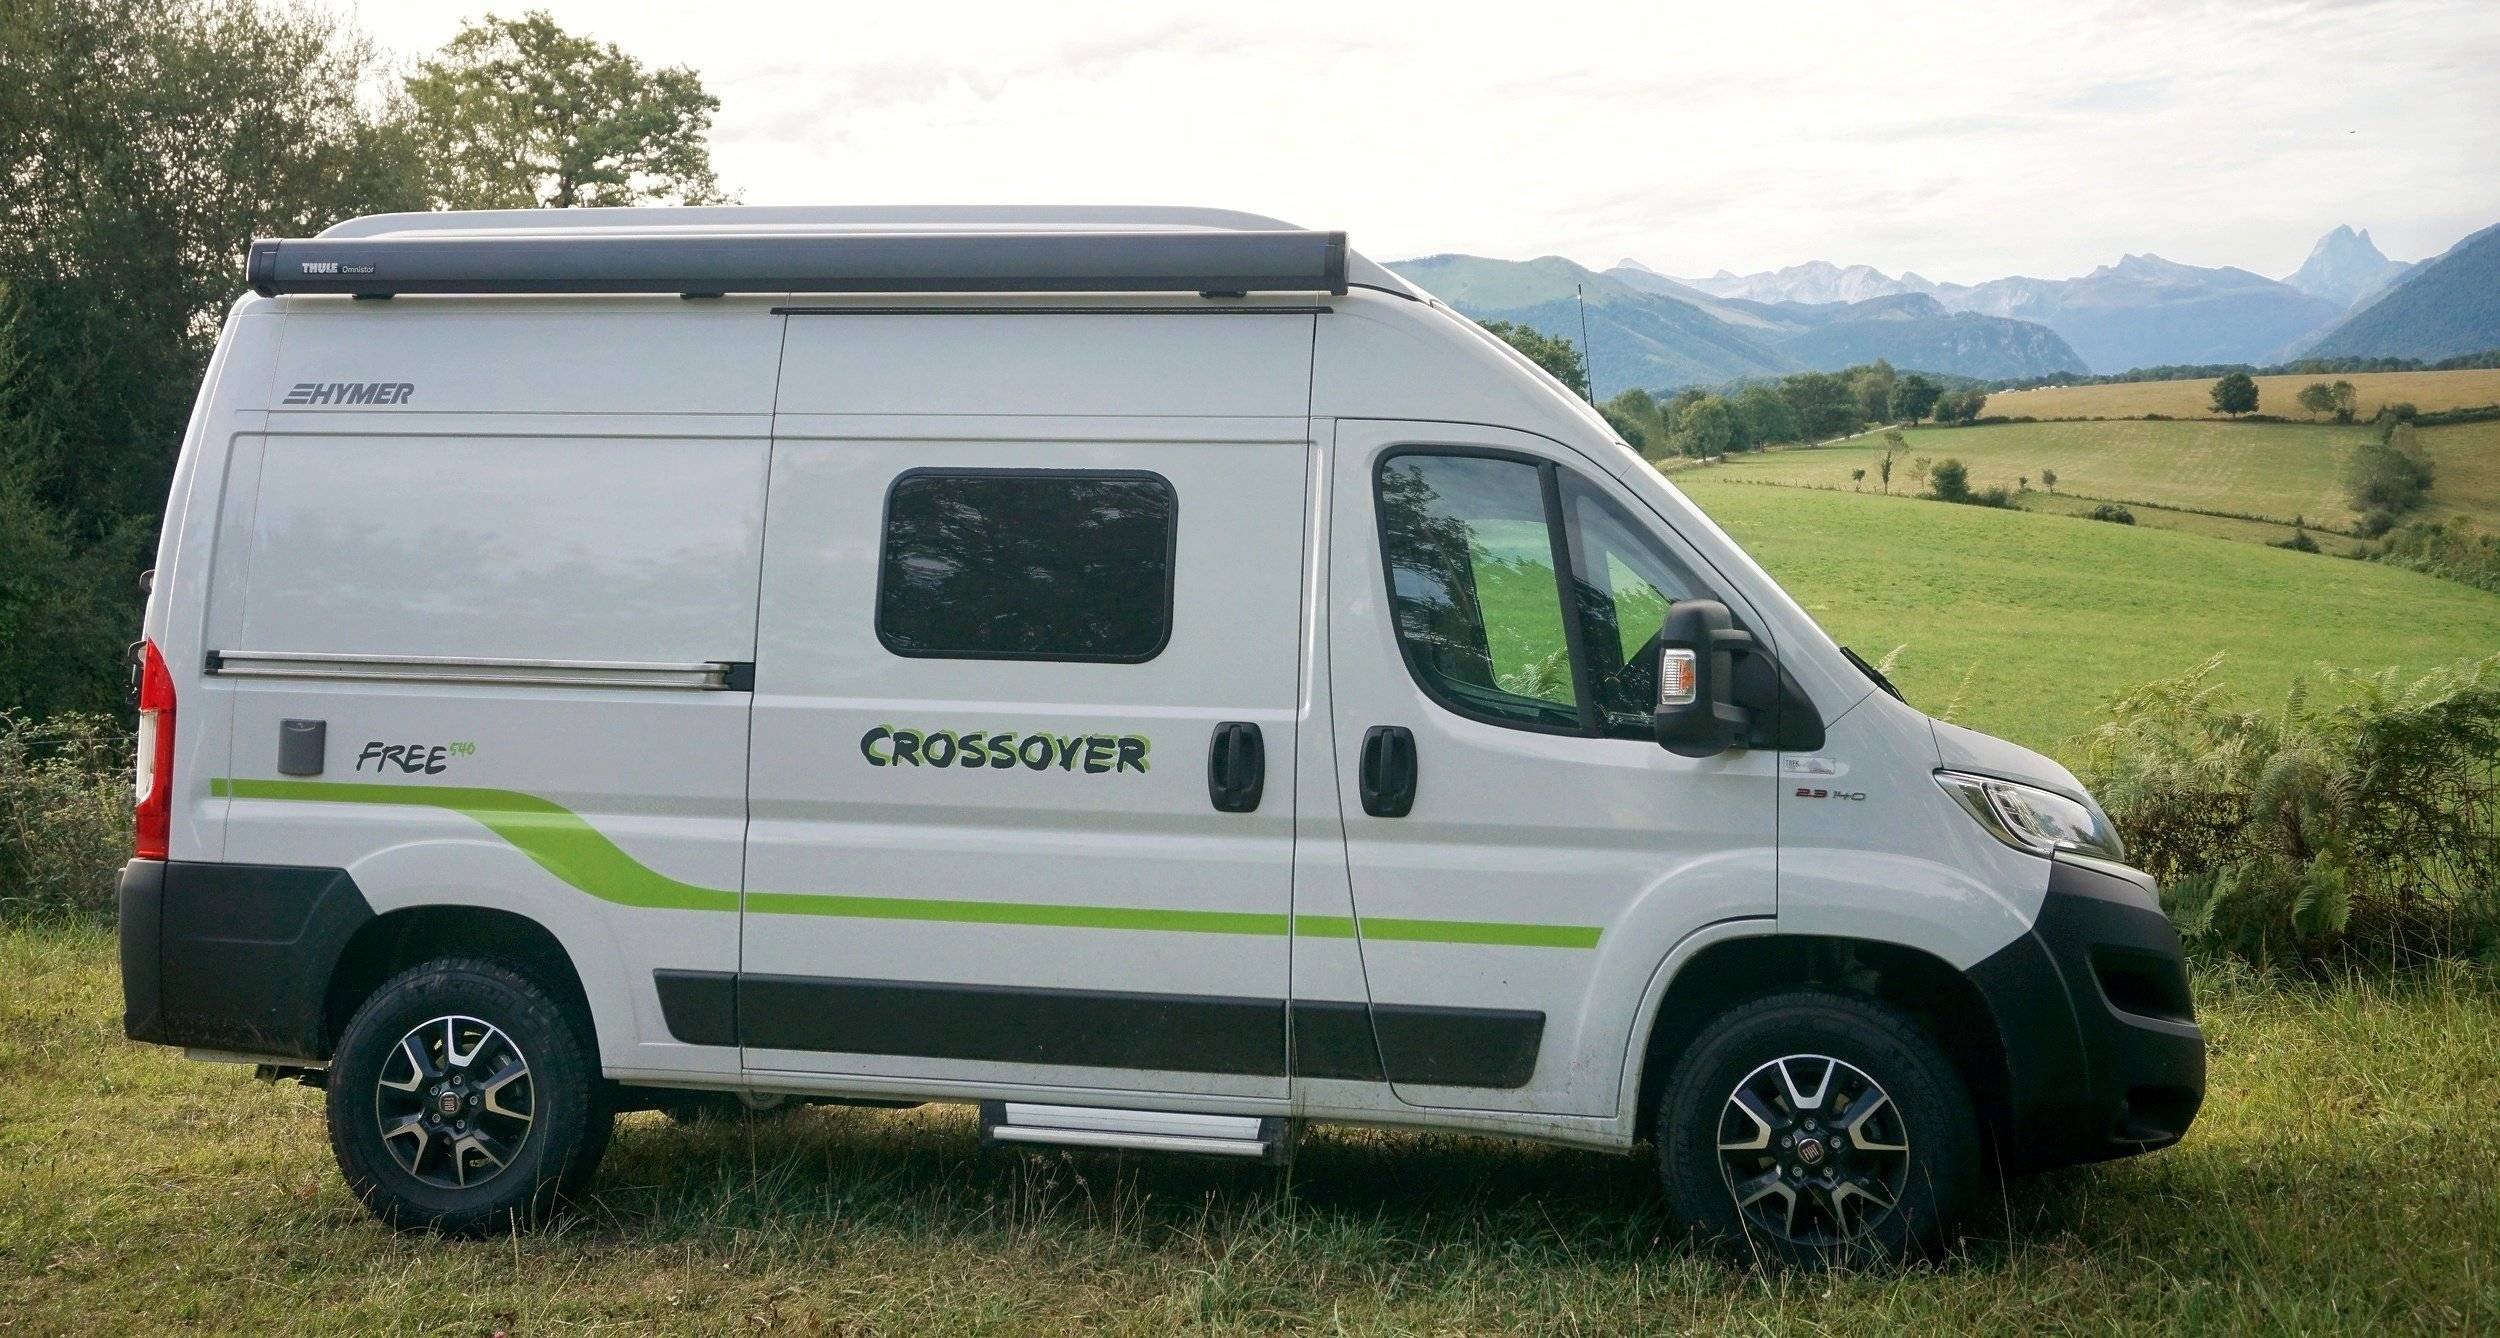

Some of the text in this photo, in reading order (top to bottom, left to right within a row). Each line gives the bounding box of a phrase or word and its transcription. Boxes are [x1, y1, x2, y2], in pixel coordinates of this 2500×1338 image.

[302, 262, 375, 274] THULE Omnistor
[306, 382, 415, 405] HYMER
[356, 741, 477, 774] FREE 540
[860, 724, 1151, 773] CROSSOVER
[1796, 788, 1828, 798] 2.3
